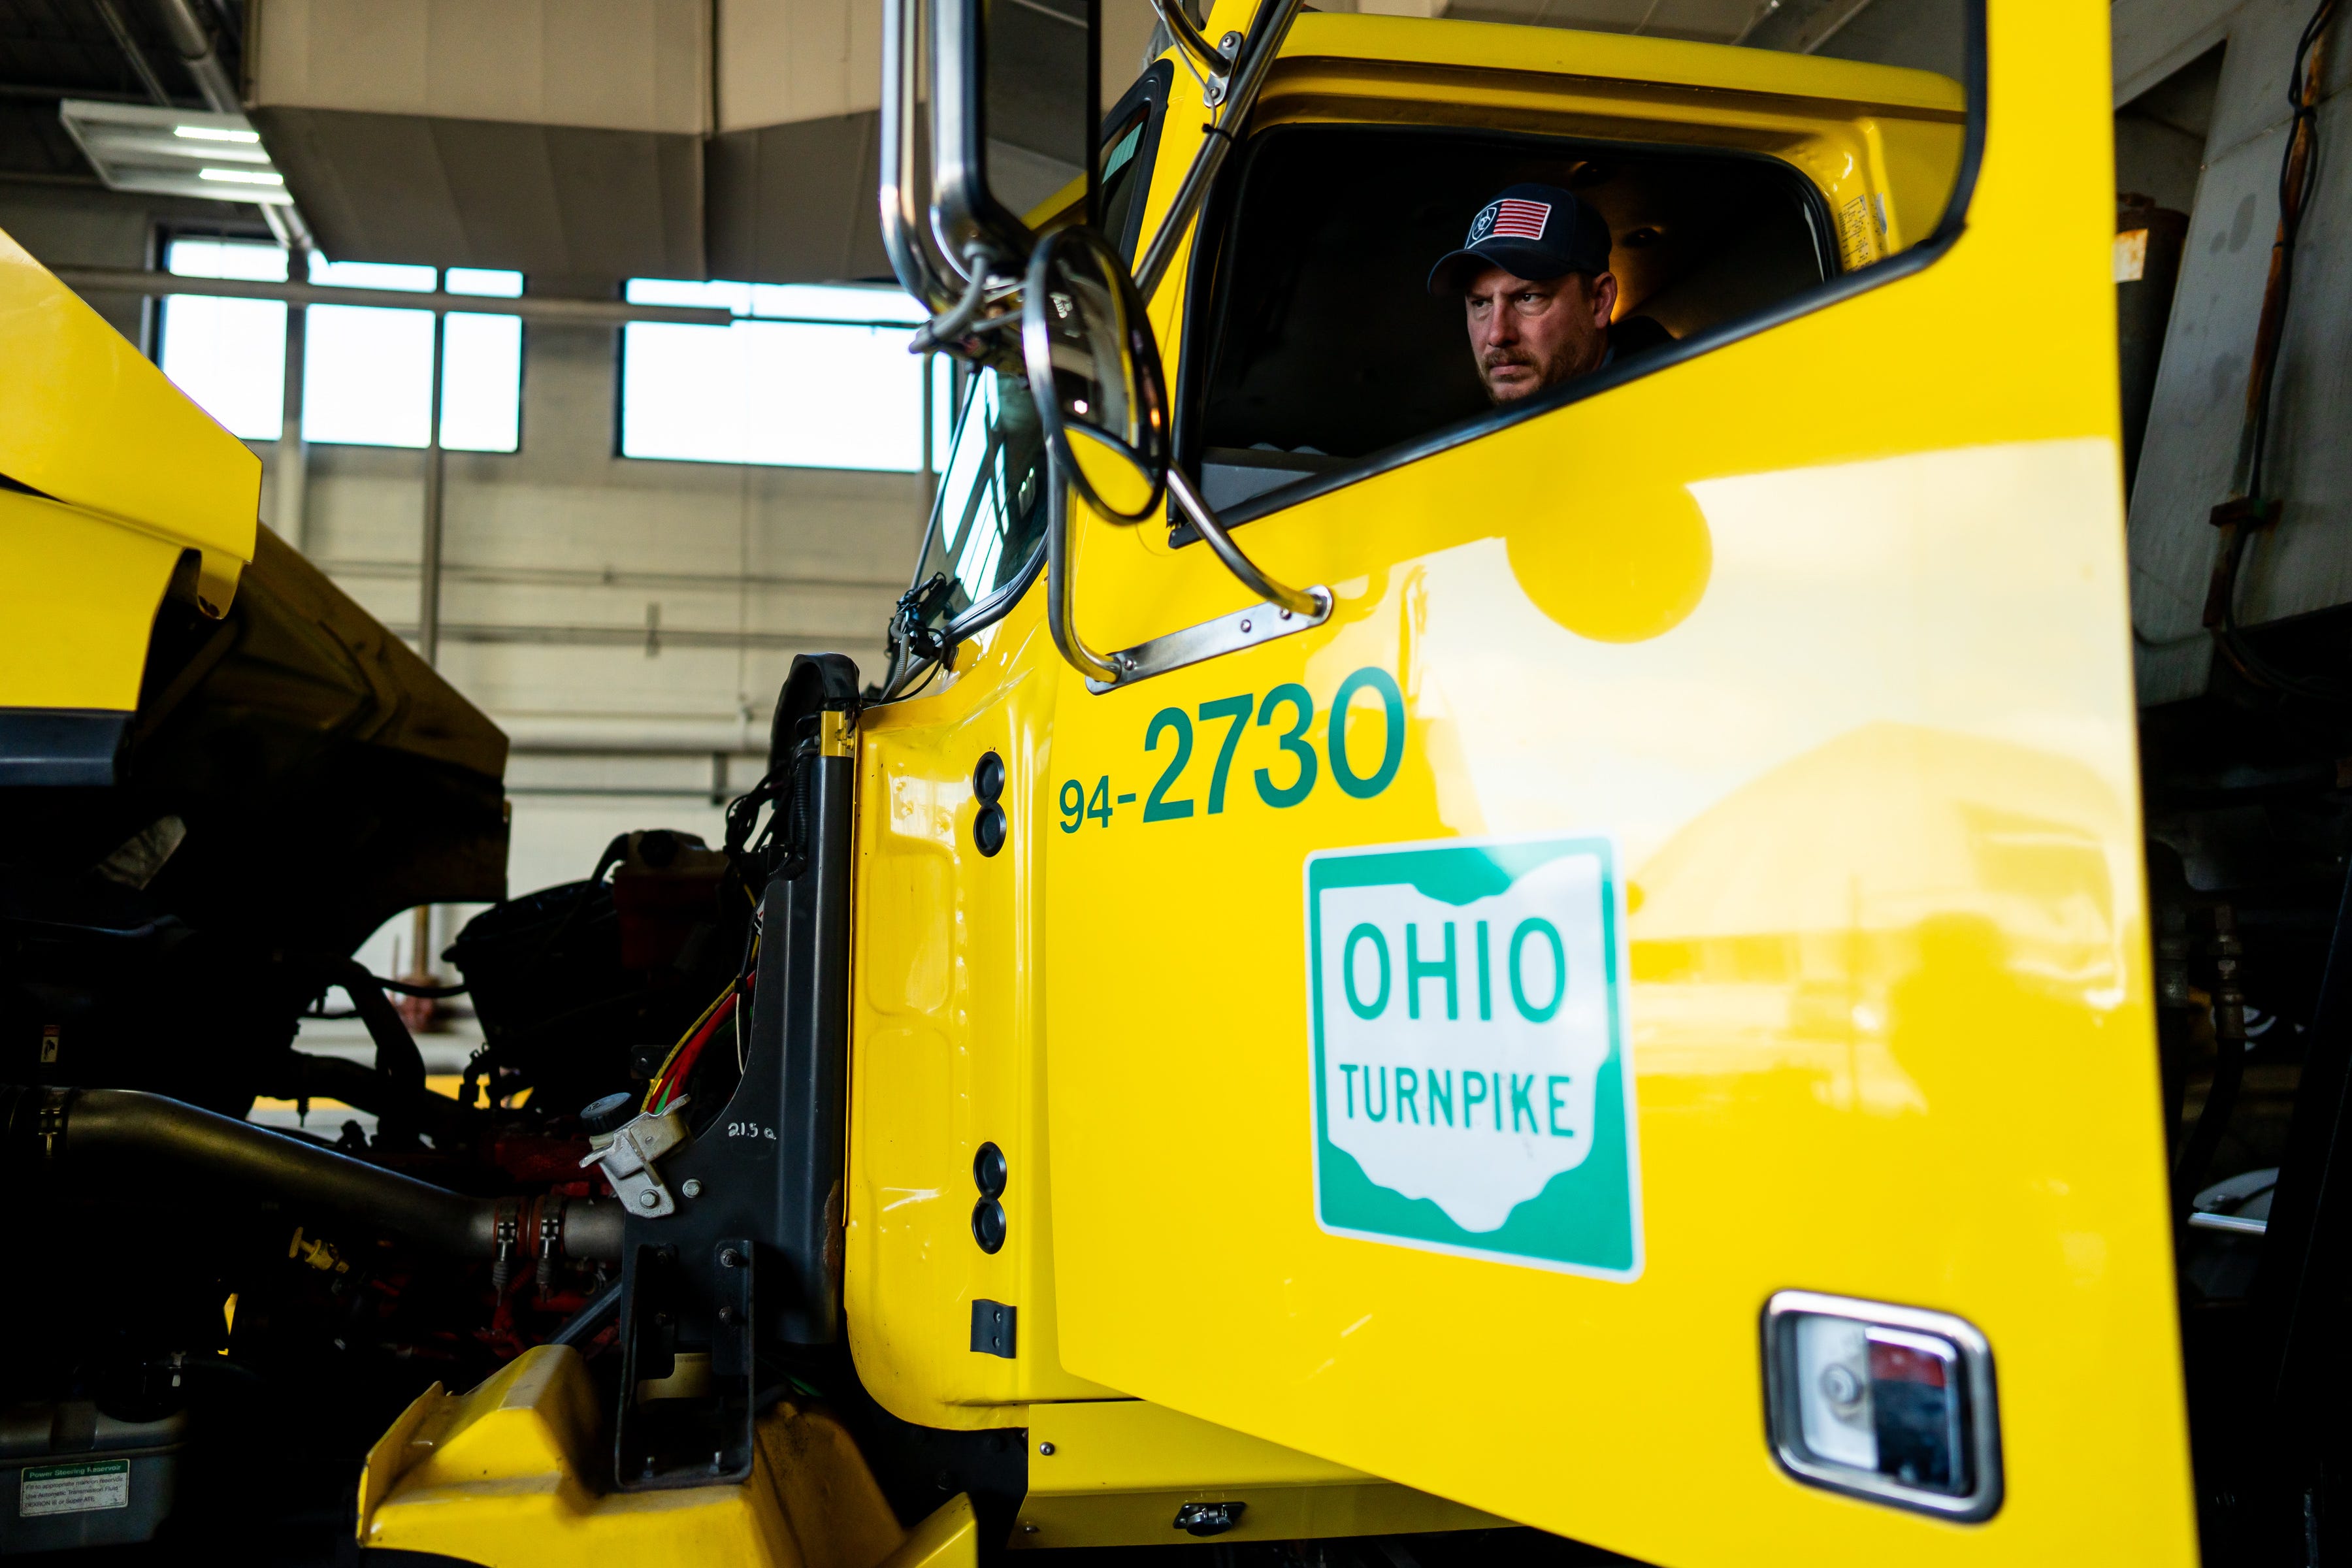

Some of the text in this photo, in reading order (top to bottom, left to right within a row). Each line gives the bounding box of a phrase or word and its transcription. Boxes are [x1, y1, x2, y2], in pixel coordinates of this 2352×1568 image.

[1059, 666, 1406, 834] 94-2730
[1343, 917, 1566, 1023] OHIO
[1339, 1064, 1575, 1138] TURNPIKE
[54, 1468, 85, 1477] Steering
[87, 1464, 121, 1473] Reservoir
